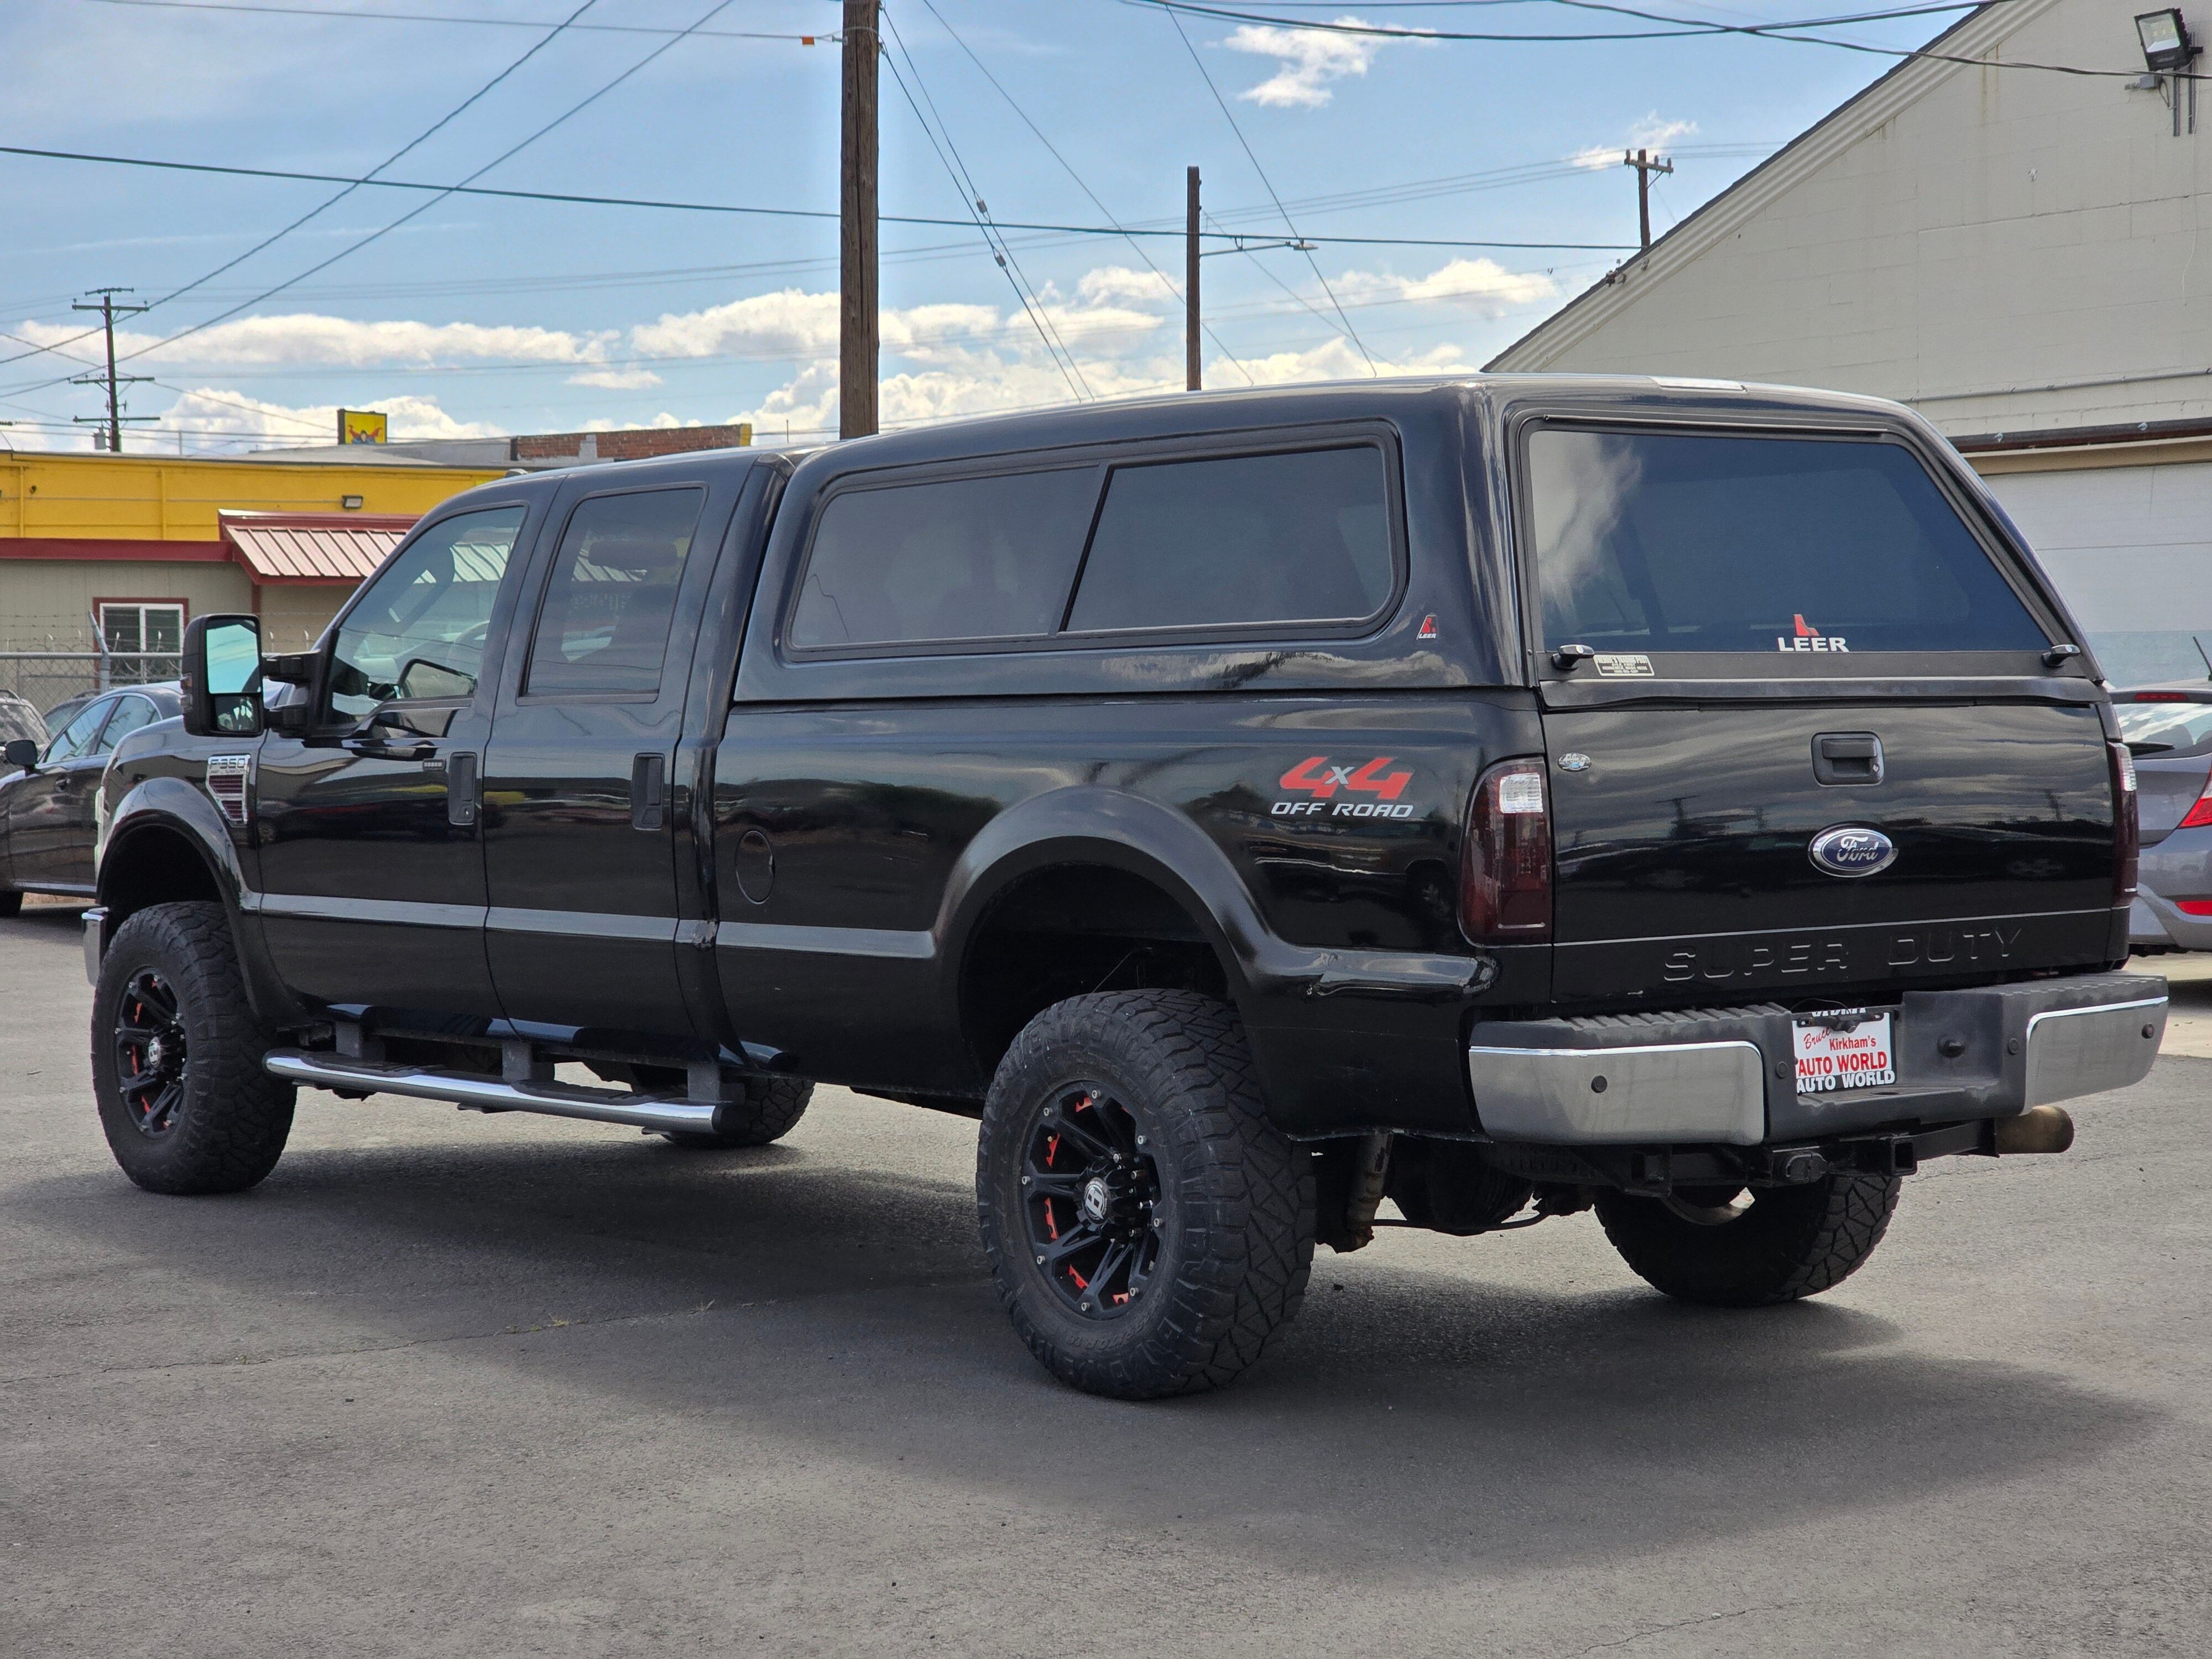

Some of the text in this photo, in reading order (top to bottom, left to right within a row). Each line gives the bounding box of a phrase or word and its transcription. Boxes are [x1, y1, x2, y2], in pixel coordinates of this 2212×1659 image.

[1777, 637, 1849, 653] LEER
[1271, 802, 1414, 818] OFF ROAD
[1837, 836, 1880, 862] Ford
[1663, 926, 2022, 982] SUPER DUTY
[1803, 1026, 1832, 1050] Bruce
[1829, 1035, 1876, 1051] Kirkham's
[1798, 1051, 1887, 1076] AUTO WORLD
[1797, 1070, 1896, 1093] AUTO WORLD
